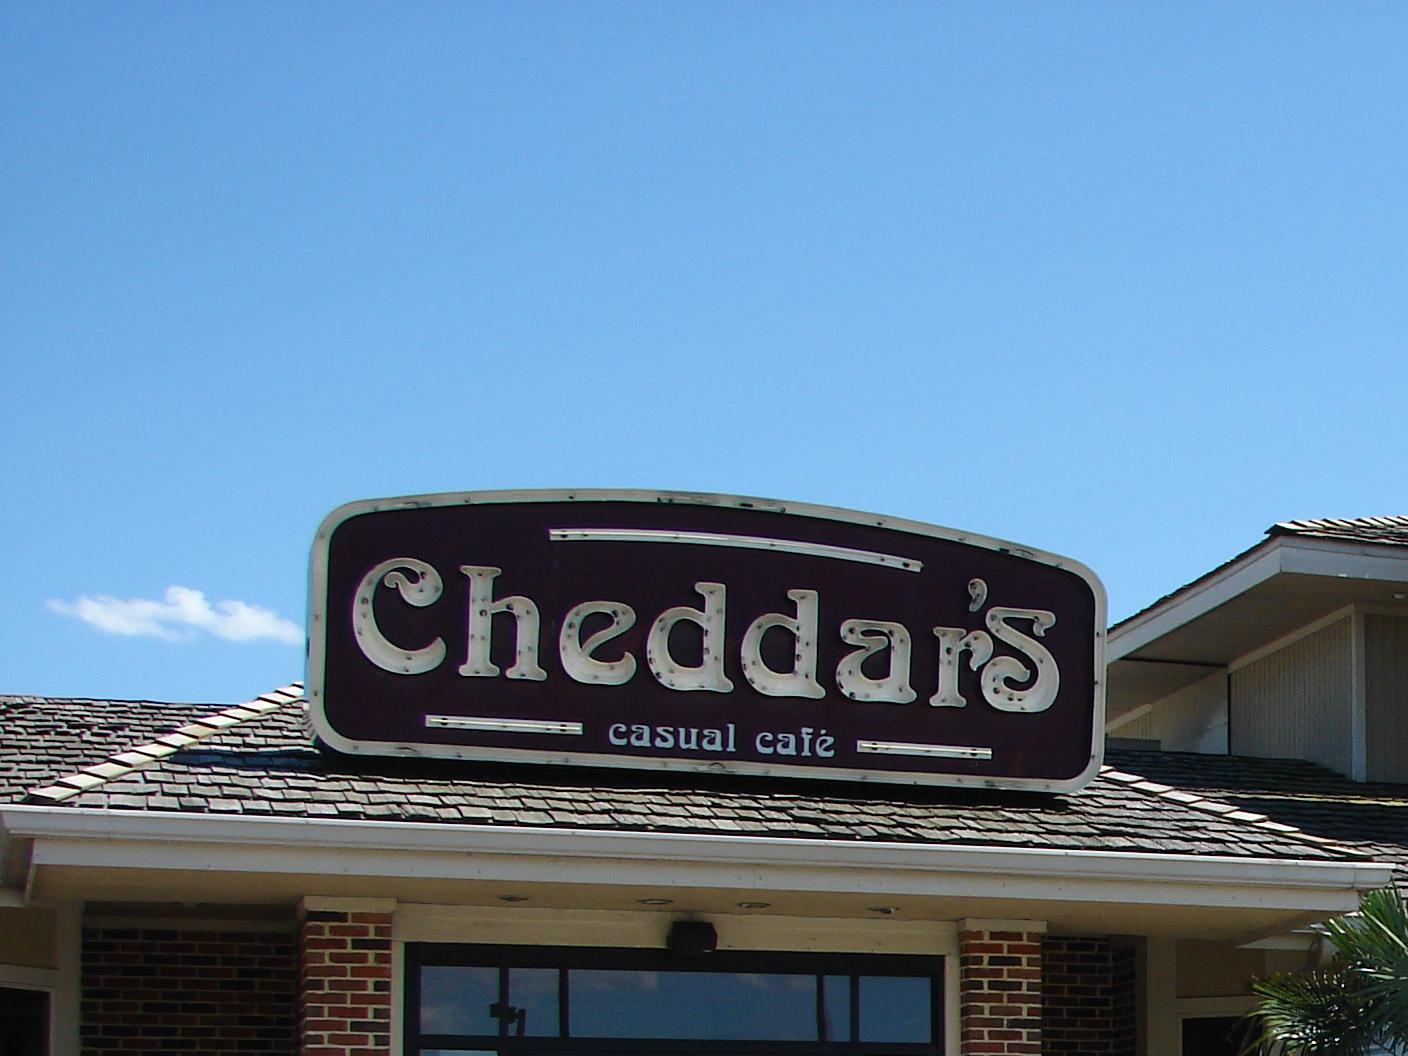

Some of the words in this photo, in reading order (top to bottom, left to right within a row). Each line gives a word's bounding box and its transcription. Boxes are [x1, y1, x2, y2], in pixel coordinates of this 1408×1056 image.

[353, 556, 1061, 713] Cheddar's
[608, 723, 736, 752] casual
[755, 727, 835, 757] café
